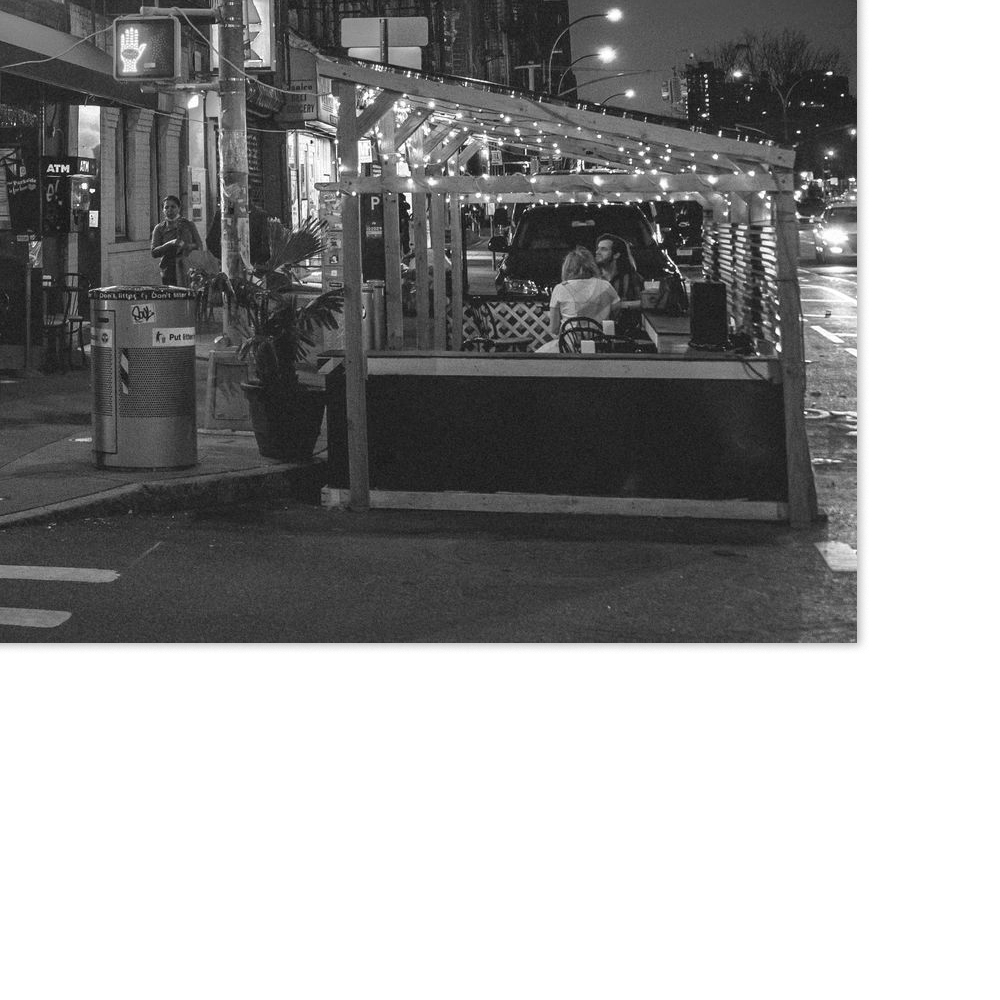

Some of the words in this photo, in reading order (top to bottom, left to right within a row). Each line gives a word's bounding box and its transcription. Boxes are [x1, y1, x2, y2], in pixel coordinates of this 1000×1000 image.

[46, 163, 70, 174] ATM
[370, 195, 381, 211] P
[169, 333, 182, 341] Put
